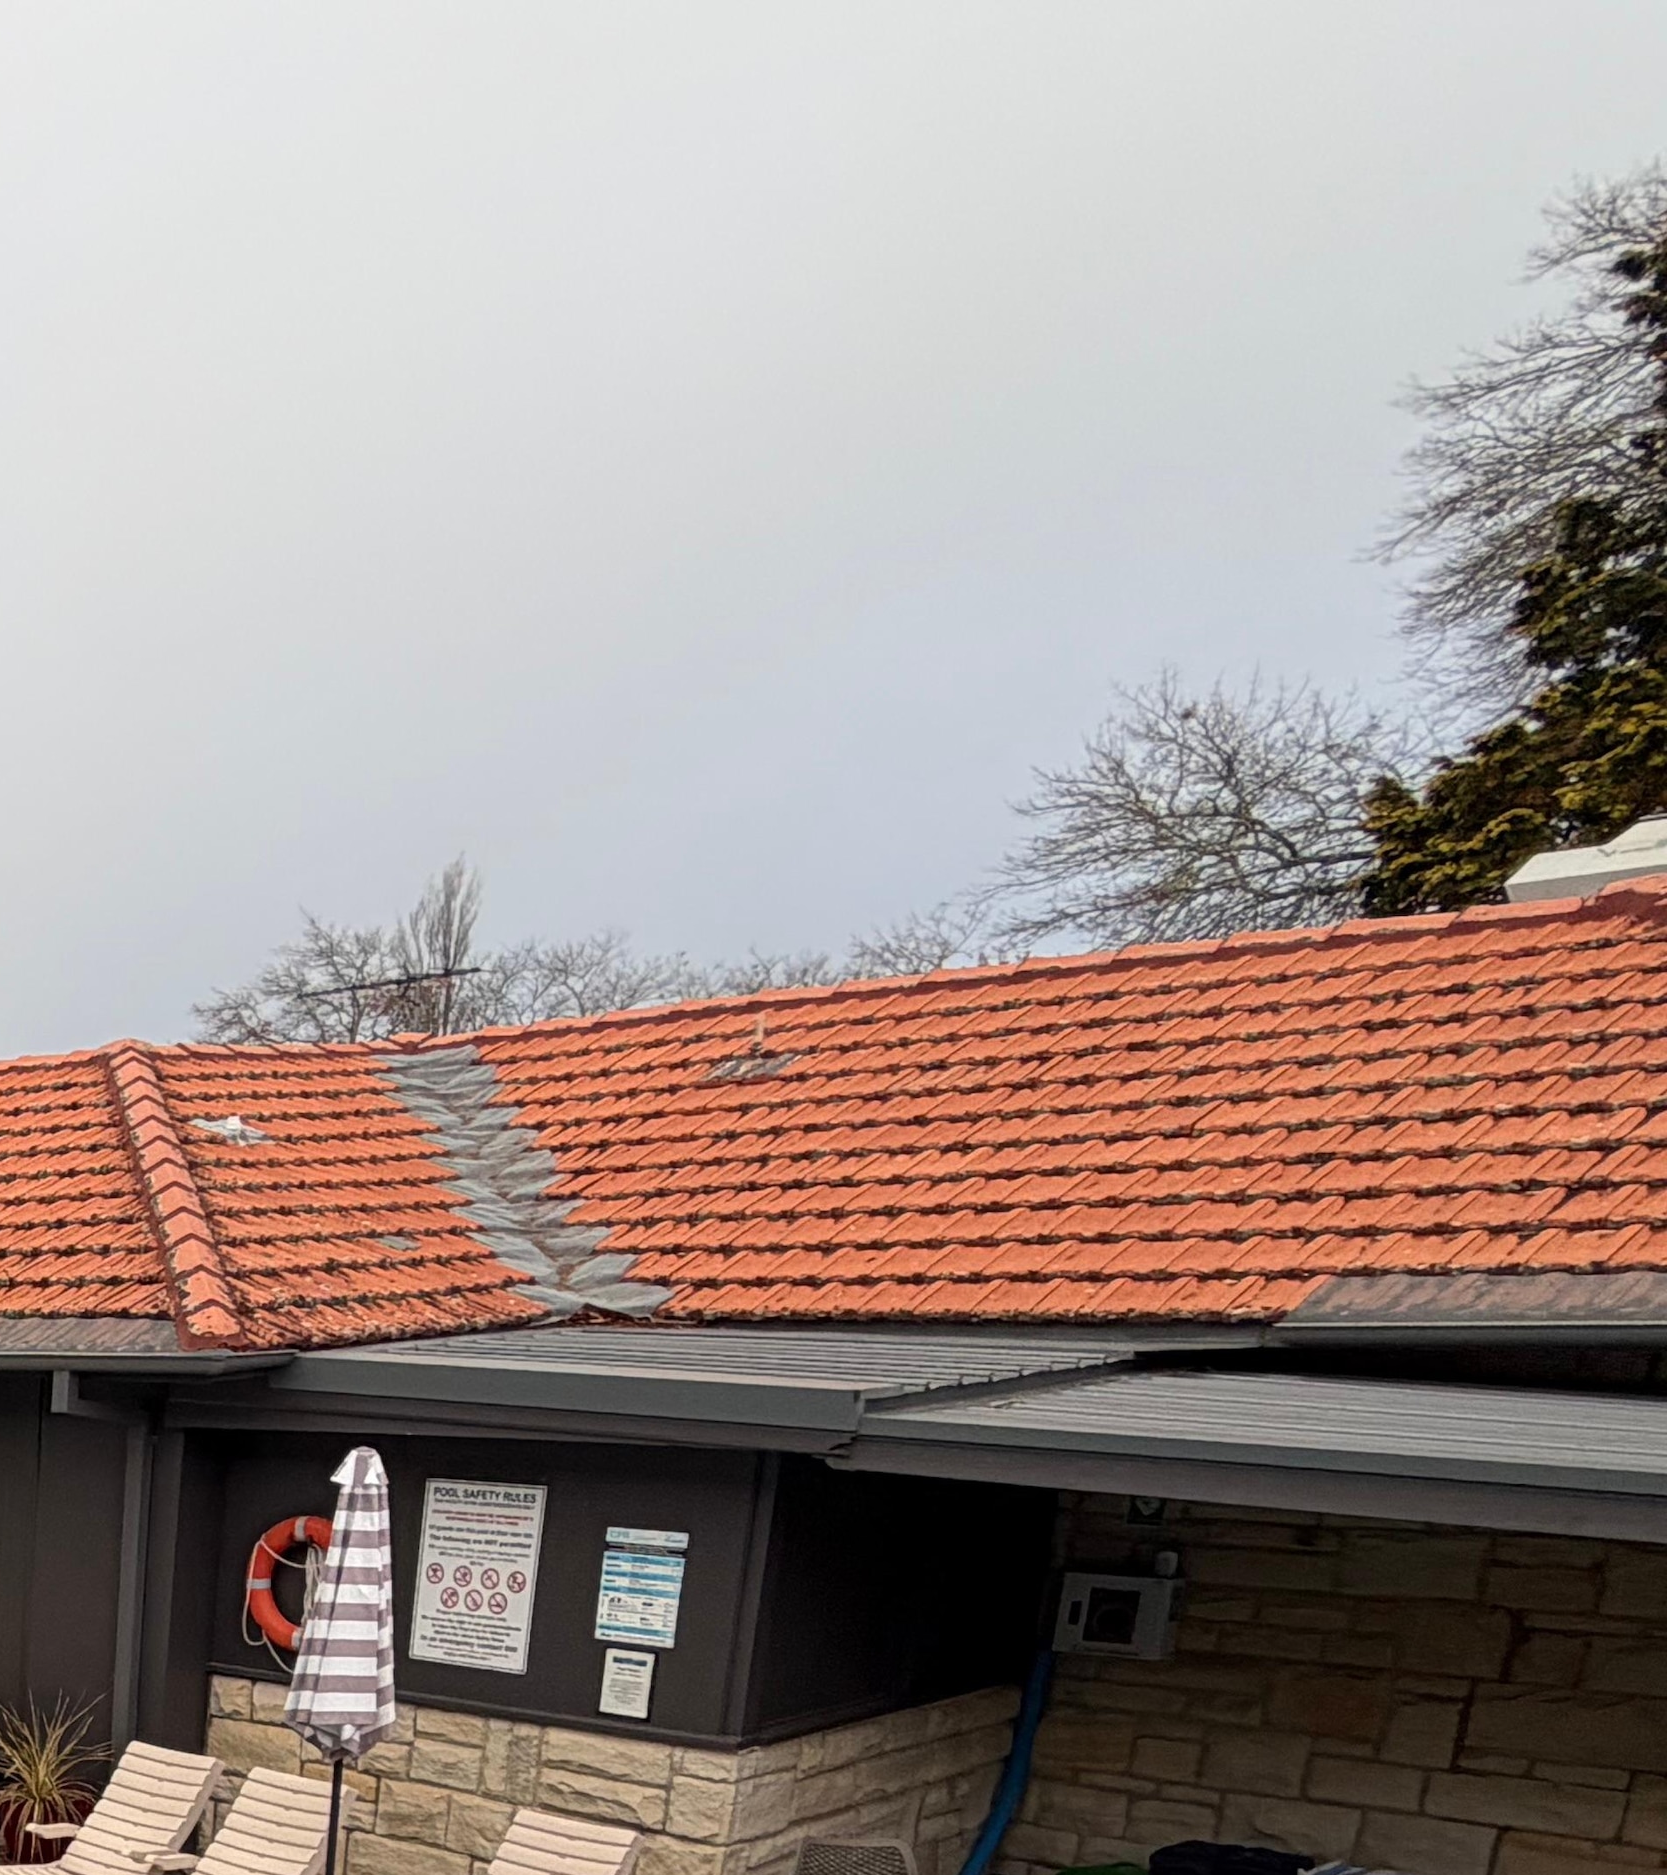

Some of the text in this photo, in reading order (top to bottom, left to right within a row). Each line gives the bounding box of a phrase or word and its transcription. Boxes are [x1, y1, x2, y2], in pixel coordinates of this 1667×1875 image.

[433, 1487, 537, 1503] POOL SAFETY RULES
